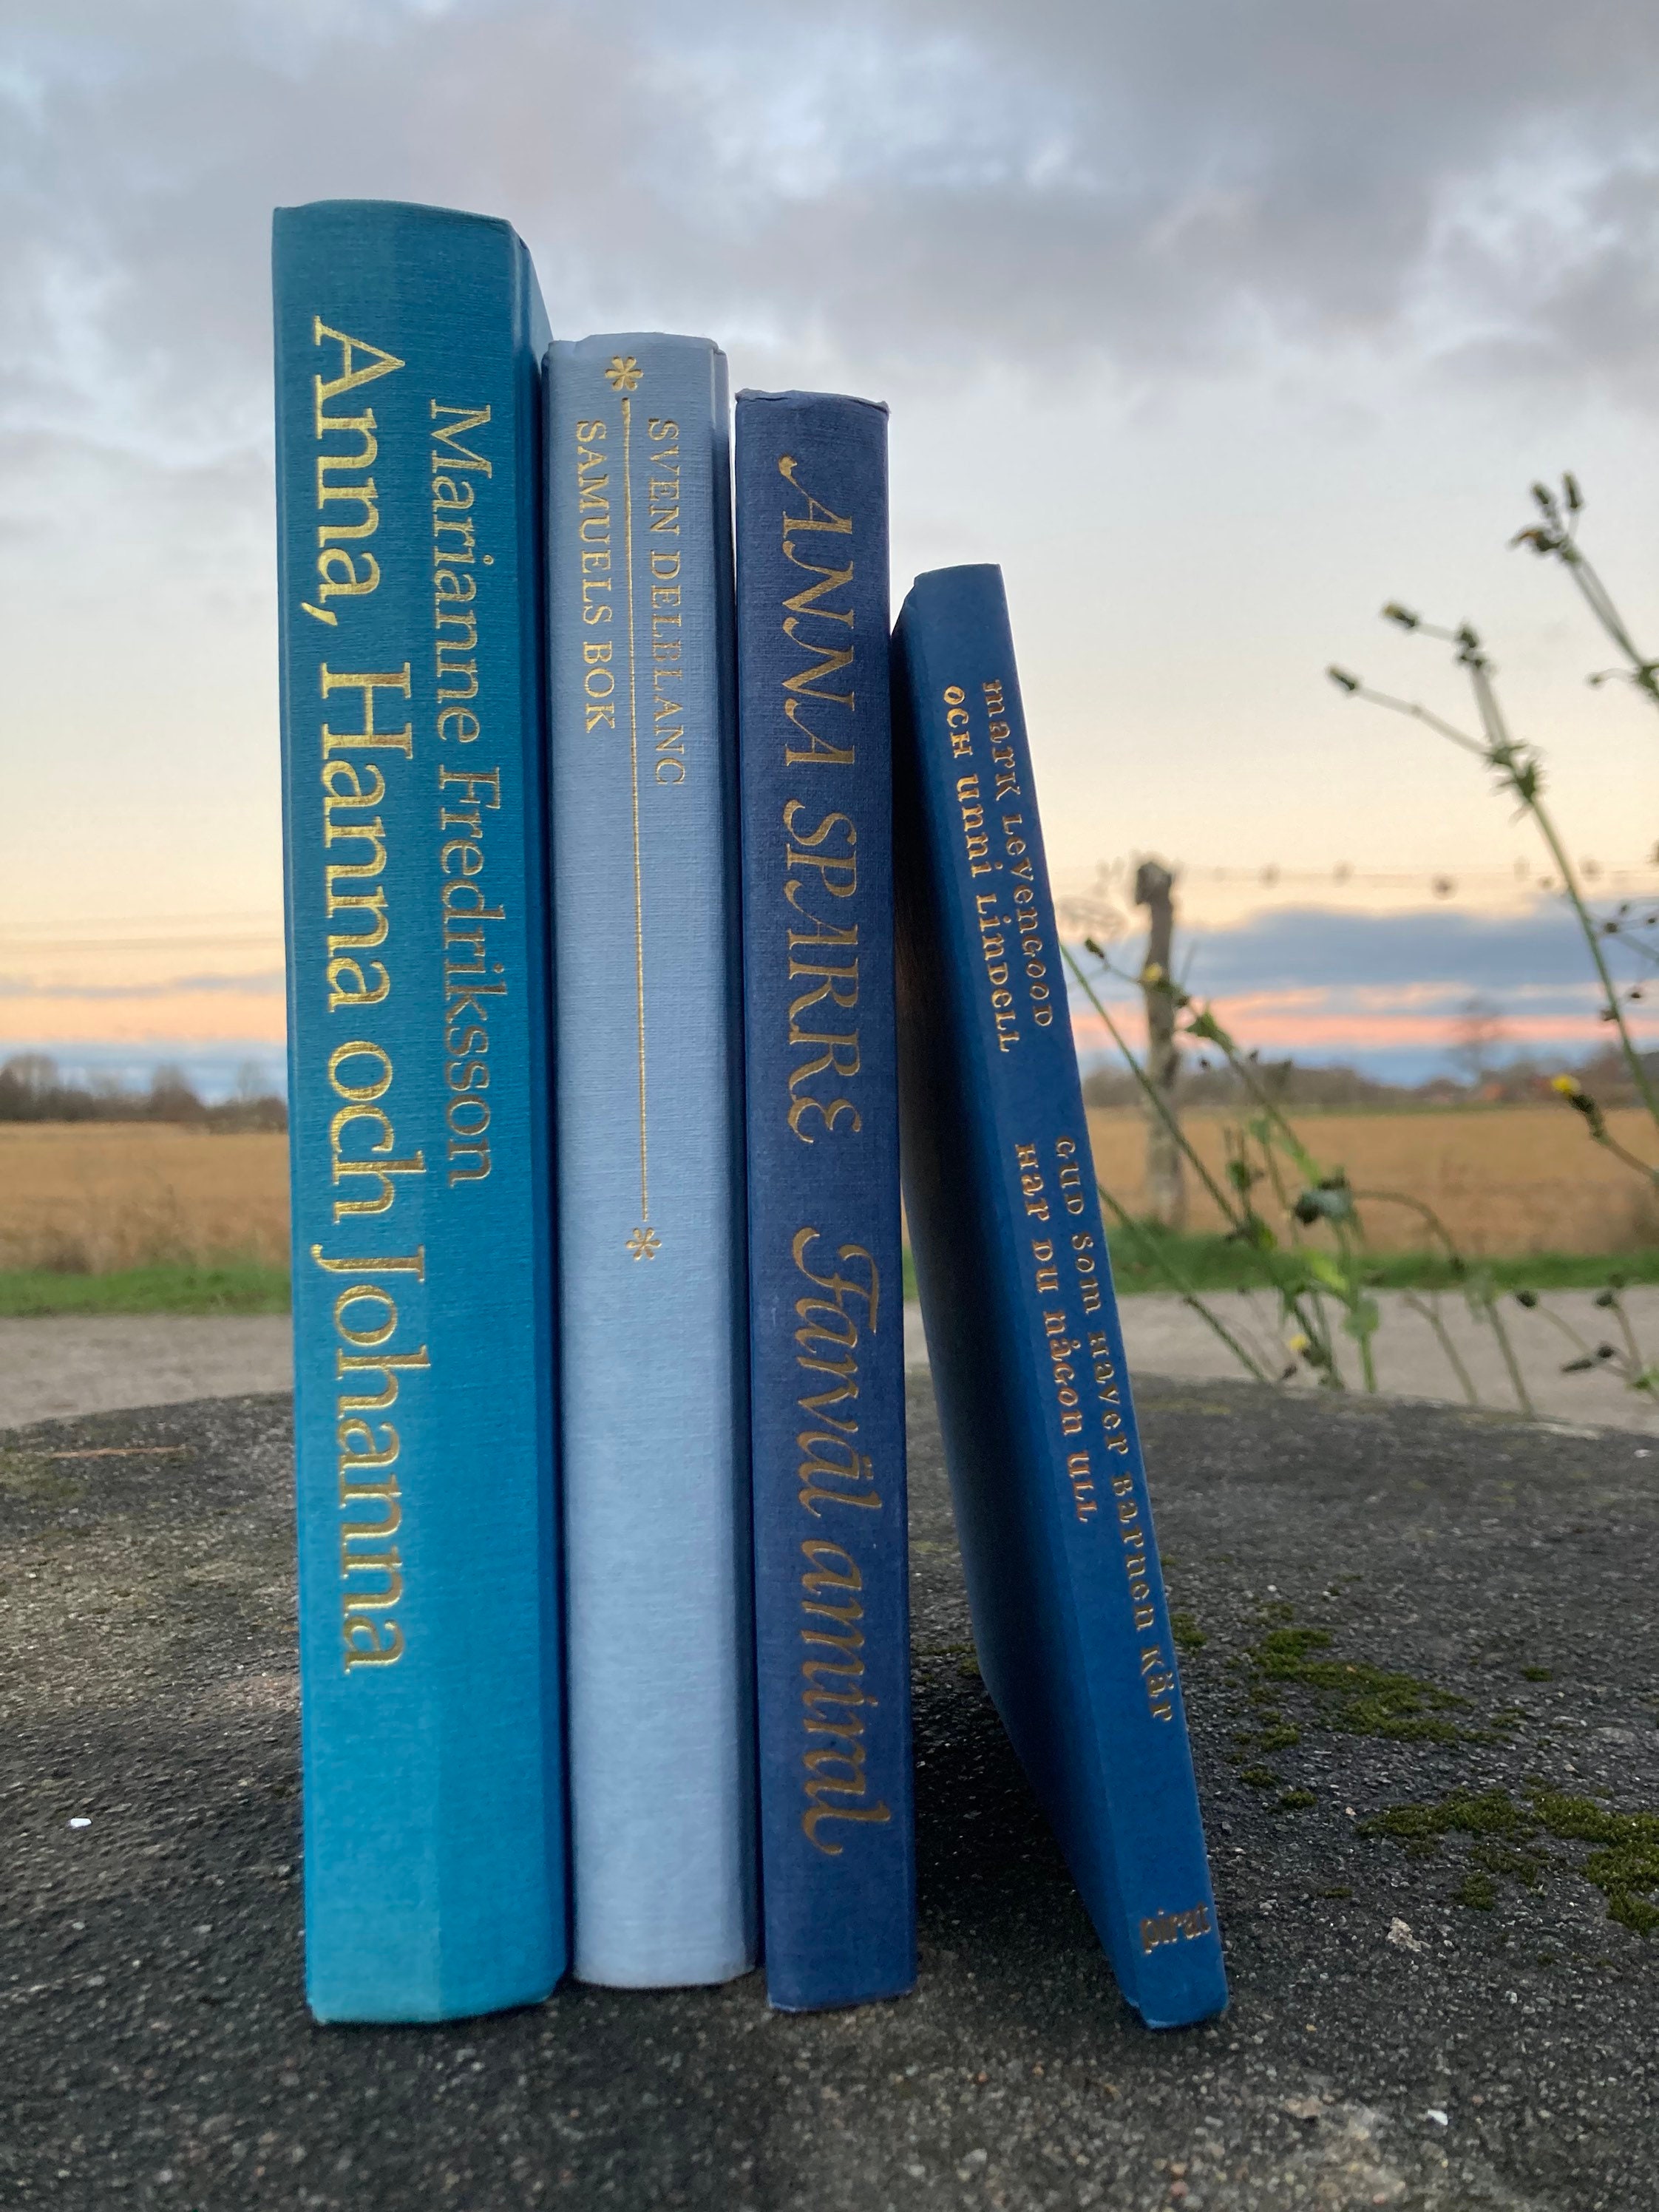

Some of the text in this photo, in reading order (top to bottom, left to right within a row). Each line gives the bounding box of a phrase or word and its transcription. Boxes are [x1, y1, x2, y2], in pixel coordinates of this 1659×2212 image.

[430, 398, 507, 1188] Marianne Fredriksson
[576, 420, 615, 733] SAMUELS BOK
[648, 418, 685, 784] SVEN DELBLANC
[778, 454, 861, 1143] ANNA SPARRE
[301, 315, 432, 1676] Anna, Hanna och Johanna
[792, 1227, 890, 1855] Farväl amiral
